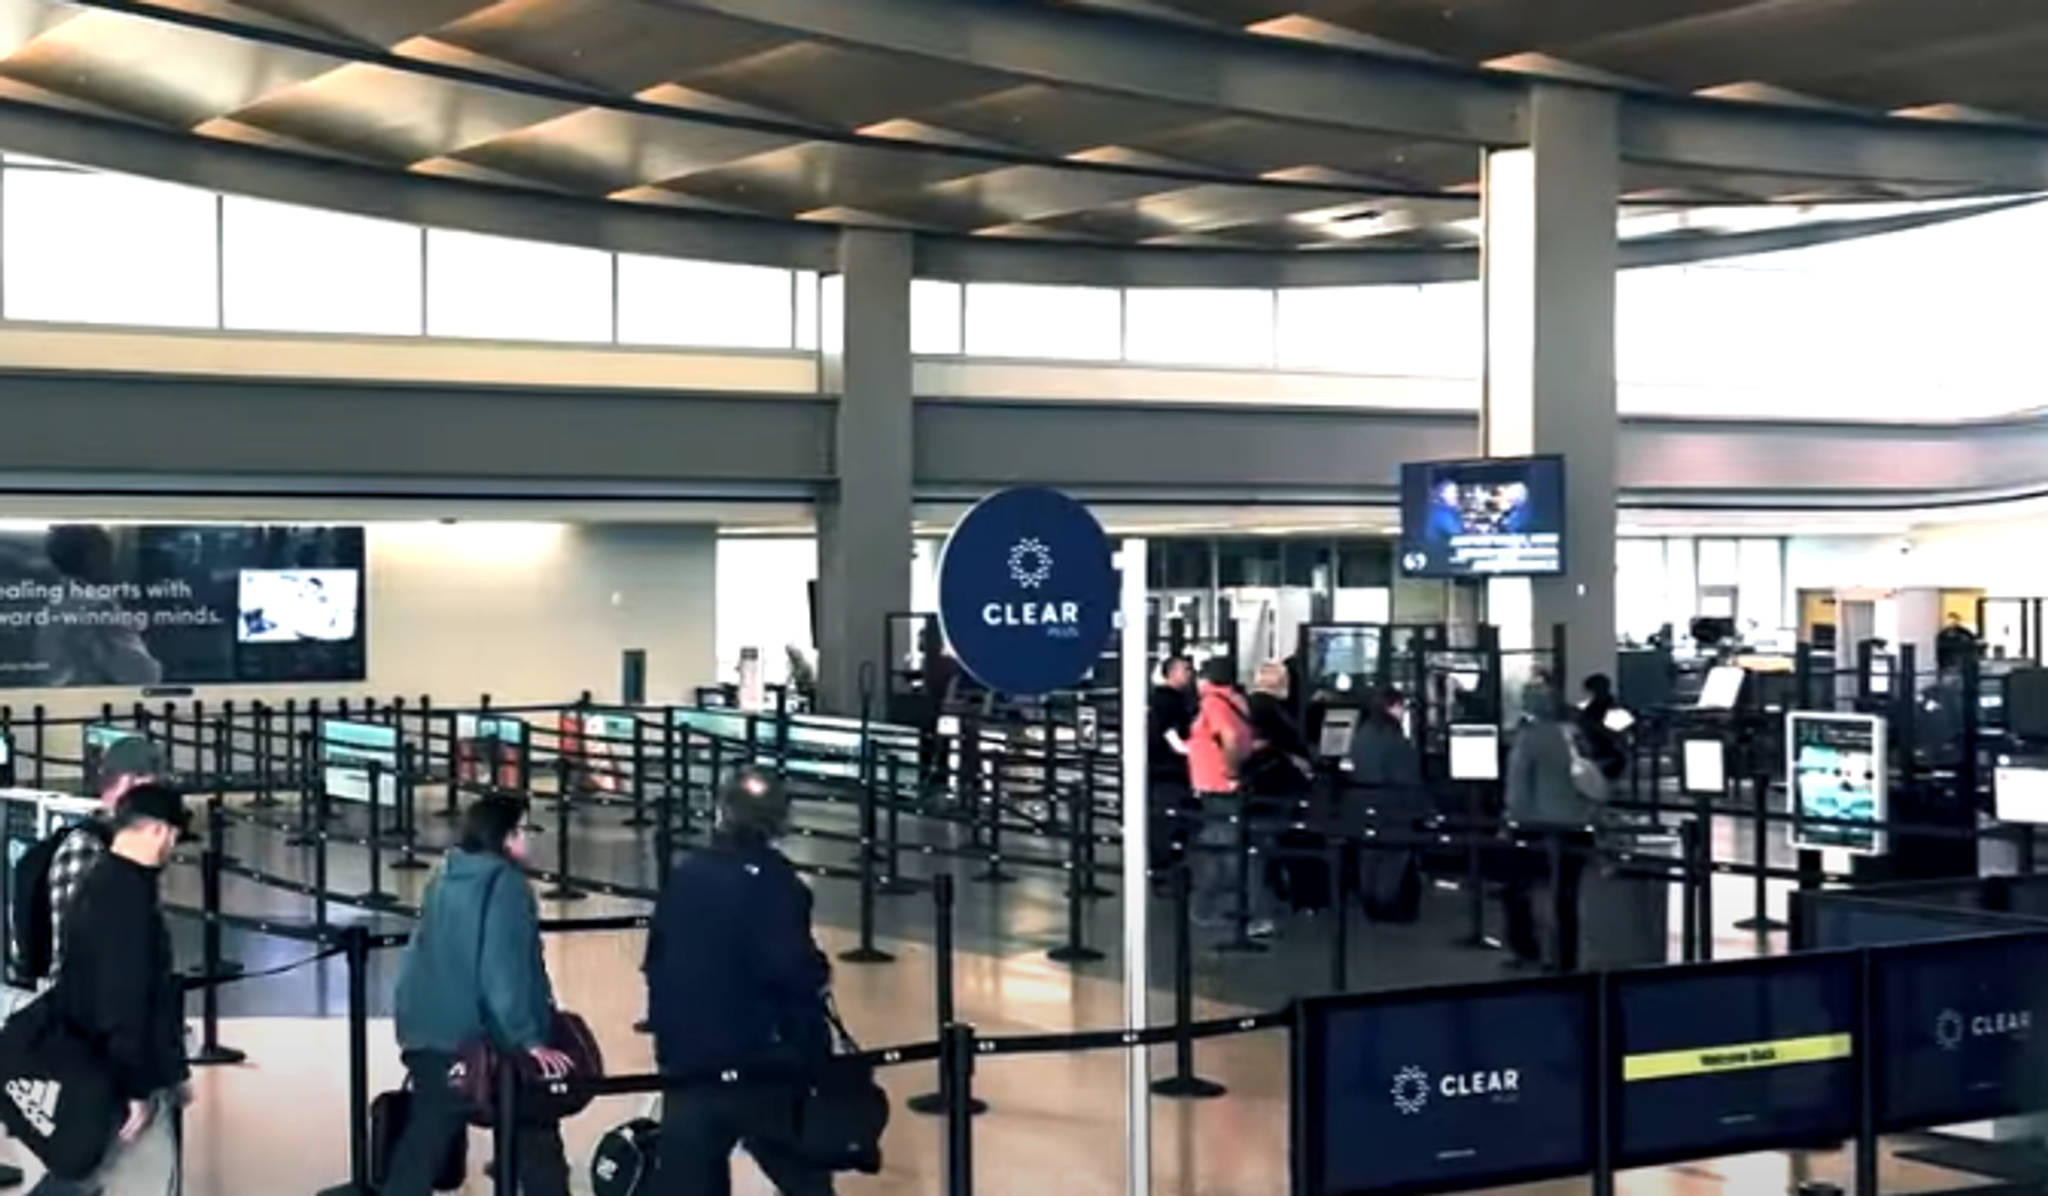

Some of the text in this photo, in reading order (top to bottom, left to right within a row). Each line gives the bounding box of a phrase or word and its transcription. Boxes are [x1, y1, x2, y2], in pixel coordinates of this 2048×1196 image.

[69, 576, 141, 599] hearts
[147, 577, 192, 598] with
[153, 605, 222, 626] minds.
[982, 602, 1079, 626] CLEAR
[1972, 1009, 2034, 1036] CLEAR
[1440, 1069, 1519, 1097] CLEAR
